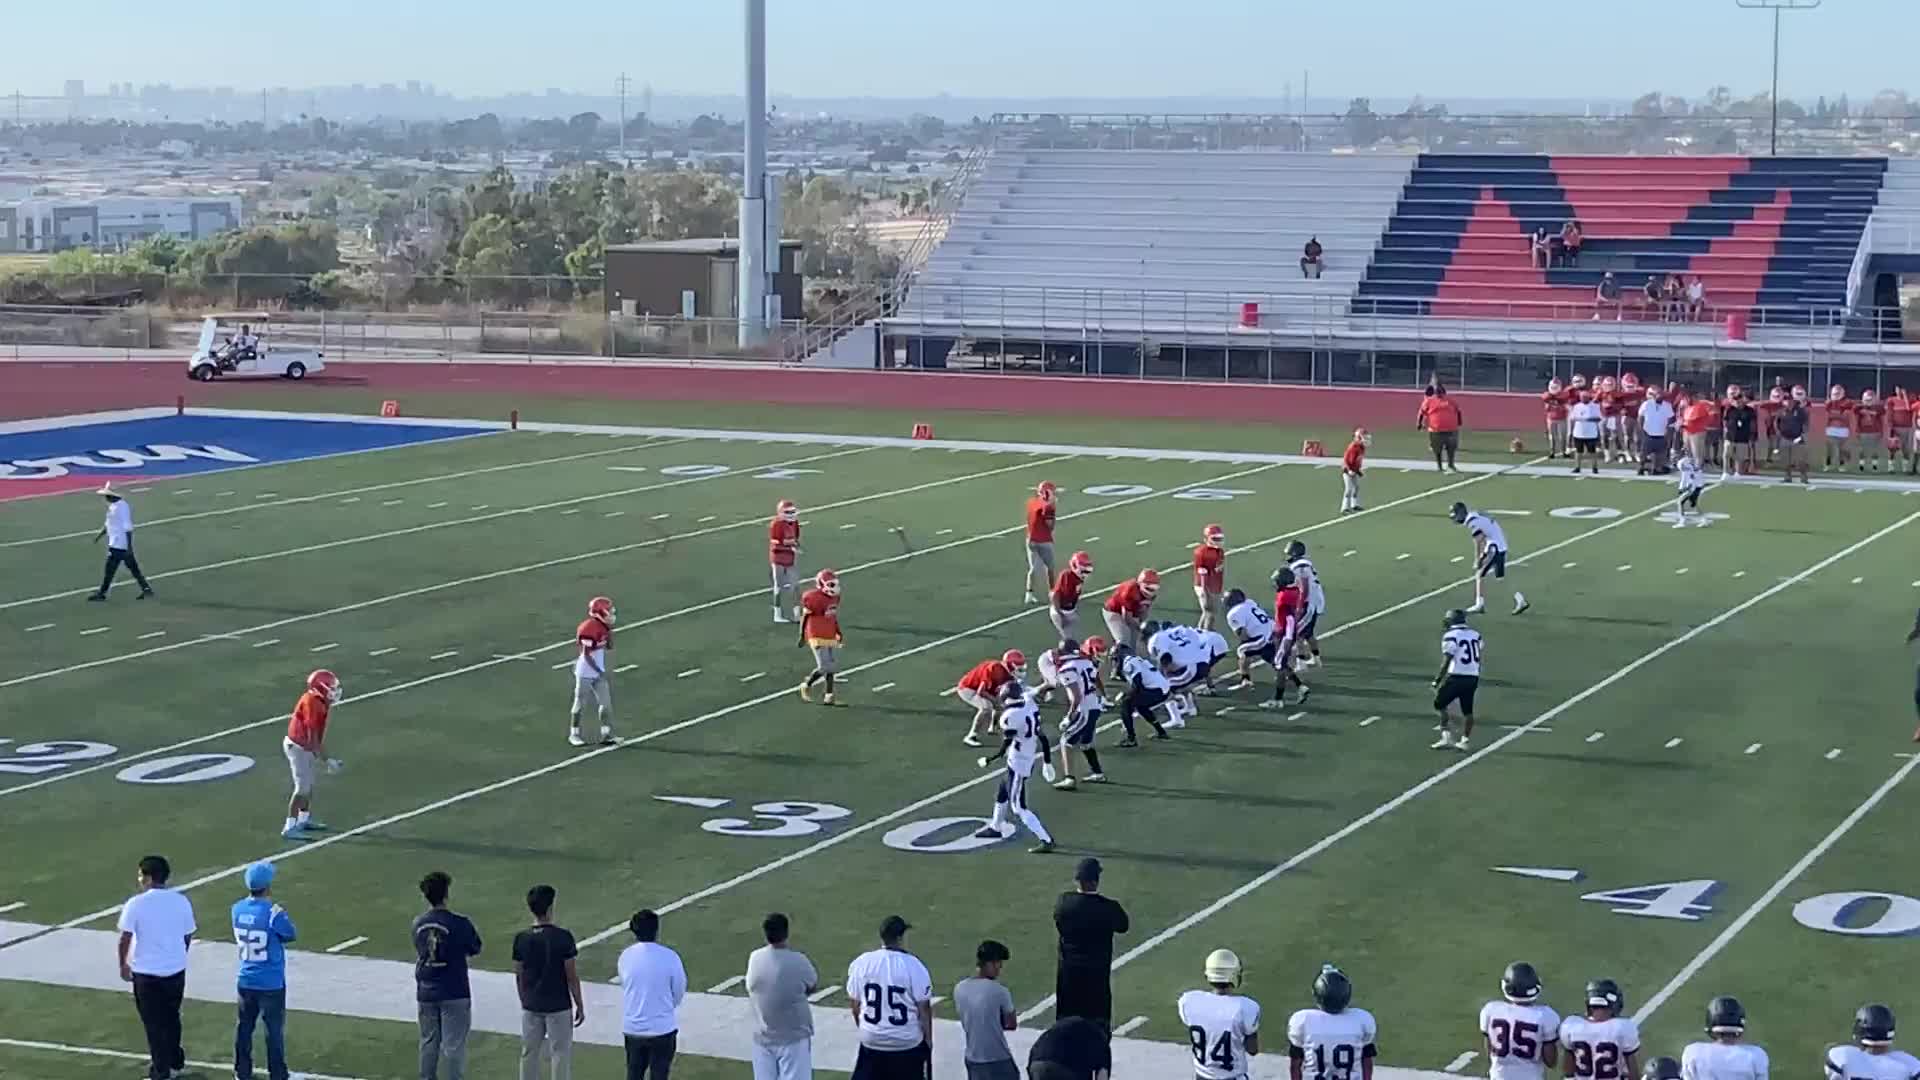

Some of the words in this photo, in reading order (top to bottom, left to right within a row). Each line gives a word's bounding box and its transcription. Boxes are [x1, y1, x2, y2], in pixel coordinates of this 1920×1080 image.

[1458, 639, 1480, 665] 30
[233, 928, 268, 961] 52
[864, 983, 909, 1026] 95
[1491, 1019, 1539, 1059] 35
[1314, 1044, 1354, 1080] 19
[1572, 1041, 1619, 1080] 32
